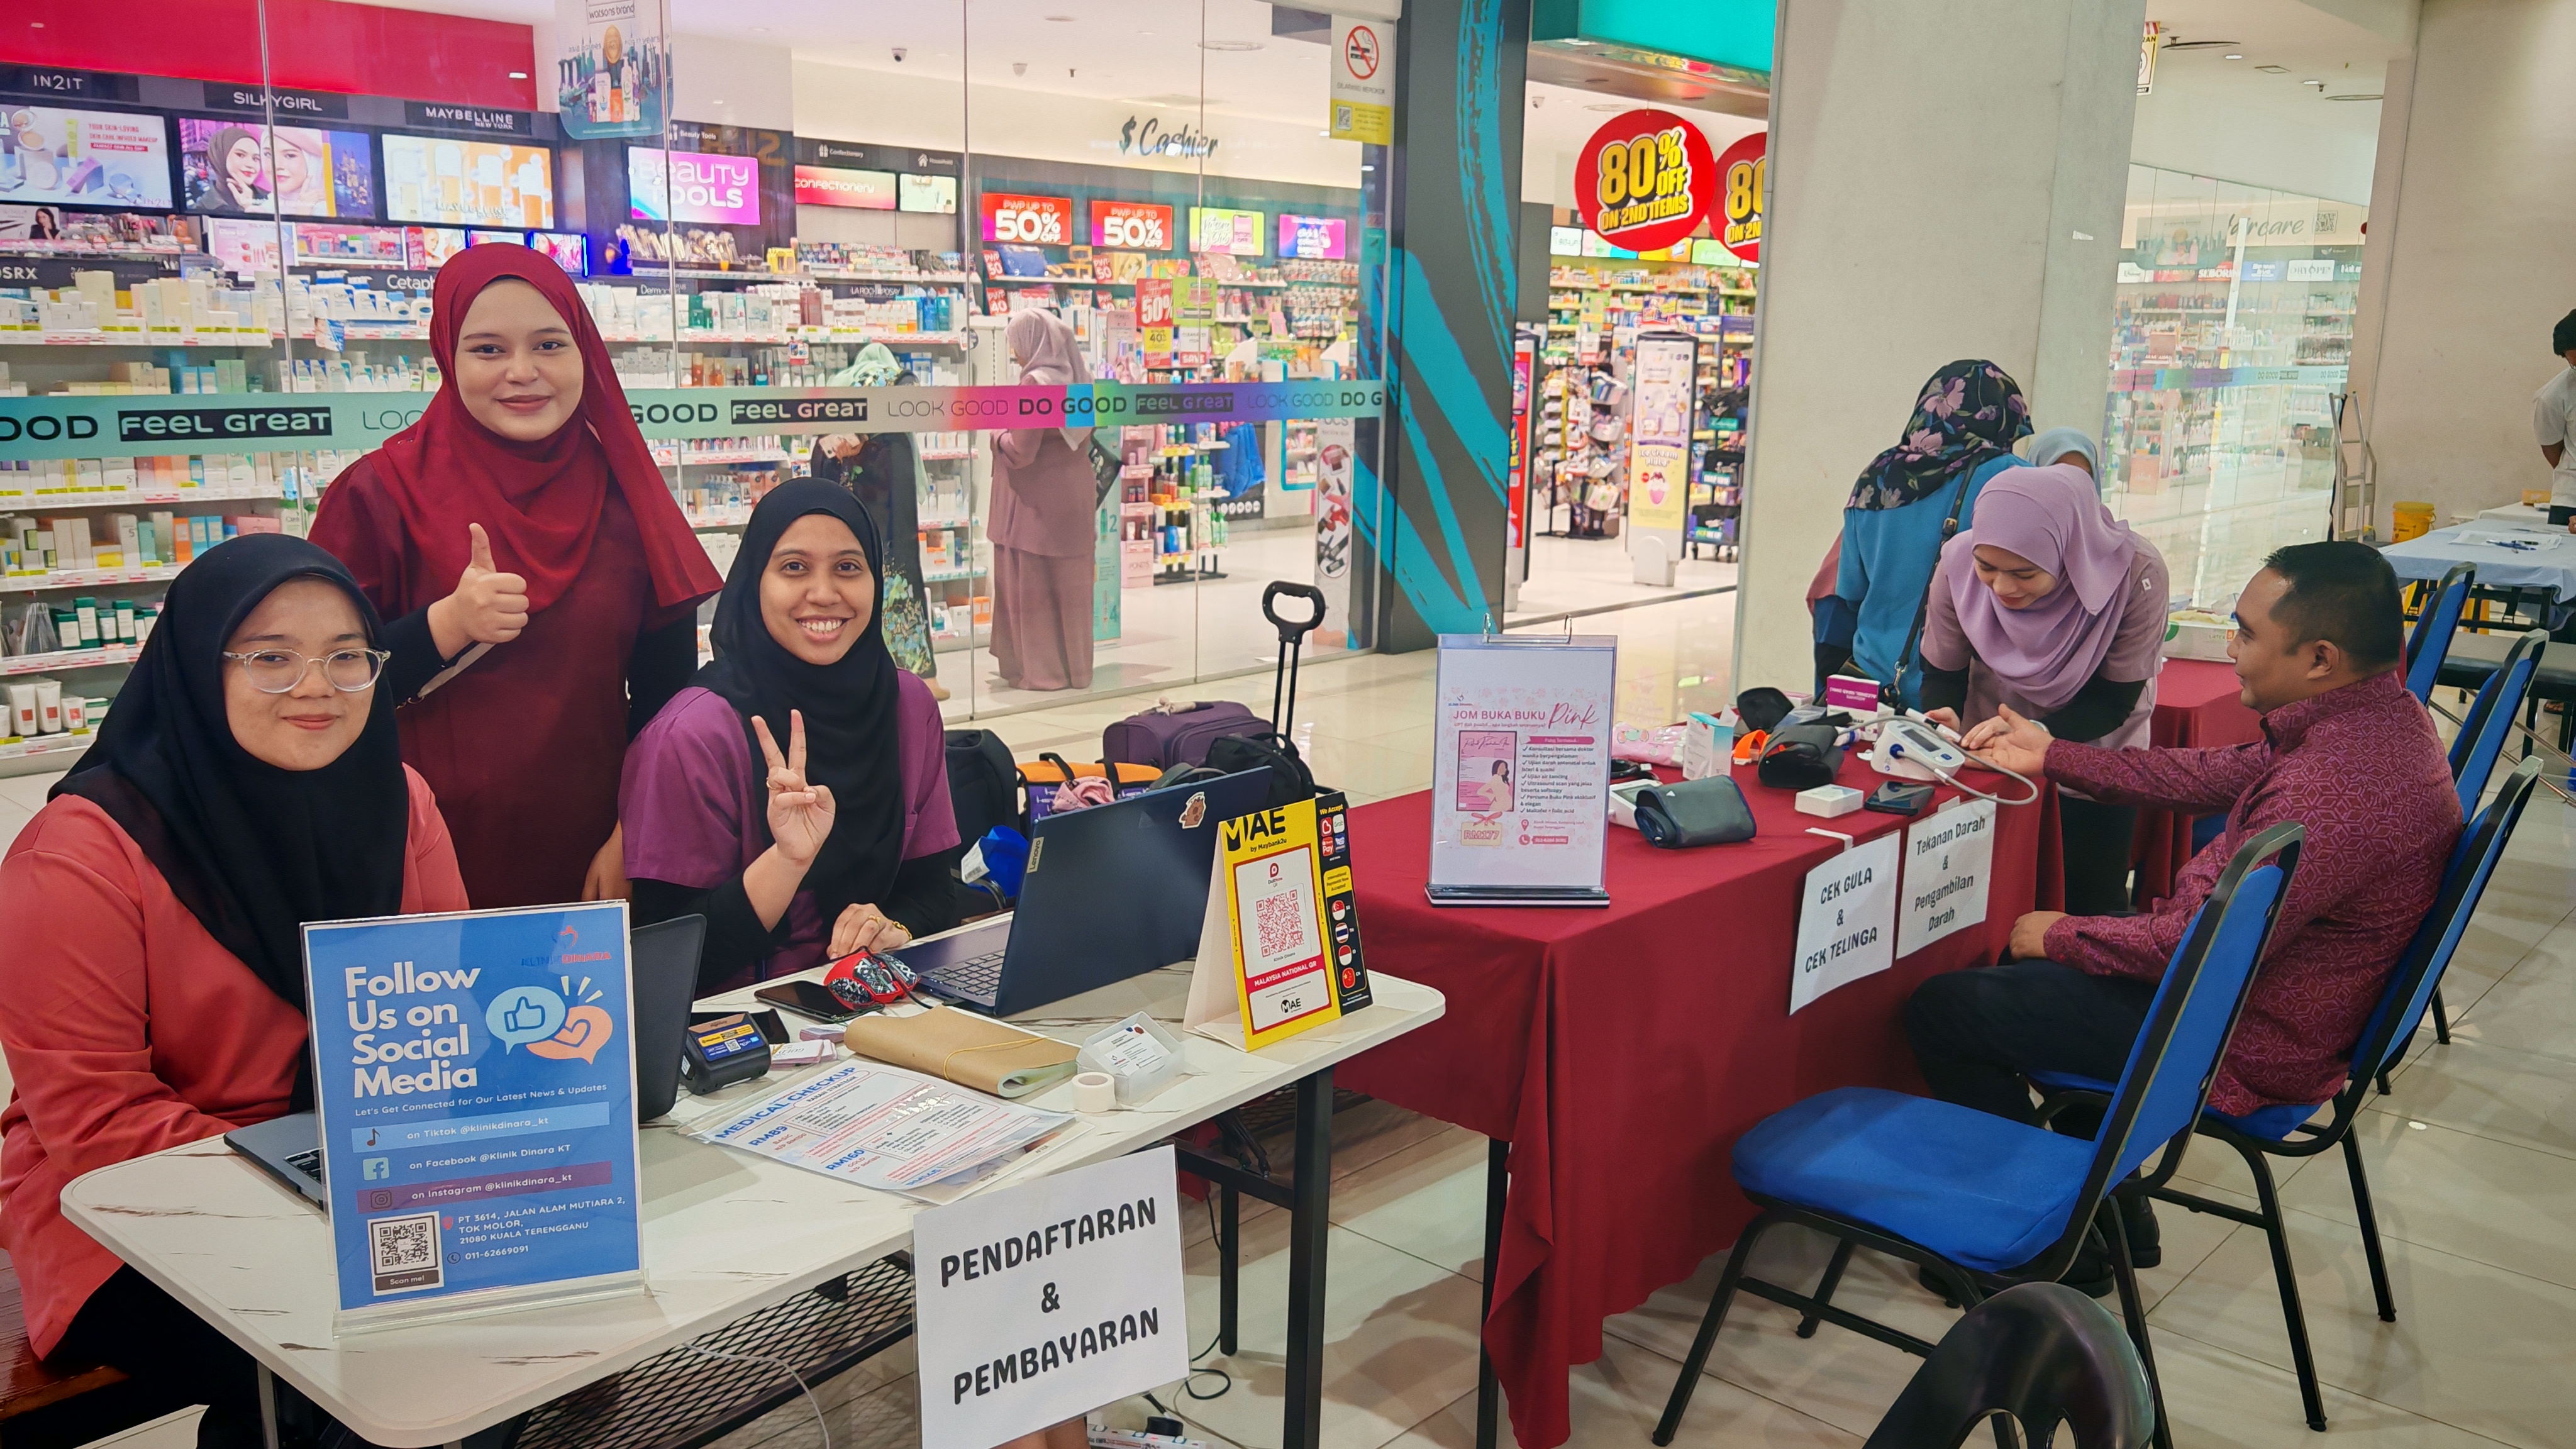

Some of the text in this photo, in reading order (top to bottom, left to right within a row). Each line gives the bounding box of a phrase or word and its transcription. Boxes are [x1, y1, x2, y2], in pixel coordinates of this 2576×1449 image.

[33, 74, 84, 91] IN2IT
[425, 106, 514, 125] MAYBELLINE
[1139, 117, 1219, 160] Cashier
[1599, 130, 1689, 206] 80% OFF
[1003, 199, 1055, 213] PWP UP TO
[1111, 208, 1158, 220] PWP UP TO
[1600, 195, 1689, 231] ON 2ND ITEMS
[995, 209, 1062, 244] 50% OFF
[1103, 217, 1163, 248] 50%
[0, 267, 38, 280] SRX
[988, 264, 1004, 275] 50
[1096, 267, 1113, 280] 50
[991, 301, 1008, 314] 40
[630, 402, 718, 424] GOOD
[887, 400, 945, 418] LOOK
[950, 399, 1009, 416] GOOD
[1019, 398, 1053, 416] DO
[1060, 396, 1128, 415] GOOD
[1248, 393, 1289, 410] LOOK
[1292, 392, 1335, 408] GOOD
[1340, 391, 1364, 408] DO
[1453, 702, 1599, 730] JOM BUKA BUKU Pink
[1250, 837, 1288, 853] by Maybank2u
[1916, 815, 1986, 857] Tekanan Darah
[1029, 840, 1041, 870] Lenovo
[1941, 854, 1949, 870] &
[1819, 867, 1872, 904] CEK GULA
[1914, 874, 1974, 912] Pengambilan
[1836, 908, 1844, 927] &
[1928, 906, 1955, 932] Darah
[1805, 926, 1878, 974] CEK TELINGA
[344, 960, 482, 999] Follow
[1254, 972, 1282, 987] MALAYSIA
[1281, 963, 1309, 977] NATIONAL
[347, 999, 458, 1033] Us on
[352, 1023, 470, 1066] Social
[353, 1060, 478, 1099] Media
[355, 1082, 608, 1117] Let's Get Connected for Our Latest News & Updates
[715, 1102, 790, 1139] MEDICAL
[787, 1067, 857, 1101] CHECKUP
[423, 1126, 457, 1138] Tiktok
[460, 1116, 549, 1135] @klinikdinara_kt
[748, 1125, 789, 1146] RM89
[409, 1143, 571, 1170] on Facebook @Klinik Dinara KT
[824, 1148, 865, 1171] RM160
[411, 1172, 572, 1200] on Instagram @klinikdinara_kt
[458, 1215, 470, 1224] PT
[503, 1207, 536, 1219] JALAN
[538, 1203, 567, 1215] ALAM
[569, 1198, 614, 1211] MUTIARA
[616, 1196, 626, 1206] 2,
[458, 1220, 524, 1234] TOK MOLOR,
[459, 1221, 589, 1245] 21080 KUALA TERENGGANU
[465, 1245, 530, 1261] 011-62669091
[940, 1196, 1157, 1288] PENDAFTARAN
[389, 1277, 409, 1285] Scan
[1041, 1282, 1061, 1314] &
[953, 1306, 1159, 1405] PEMBAYARAN
